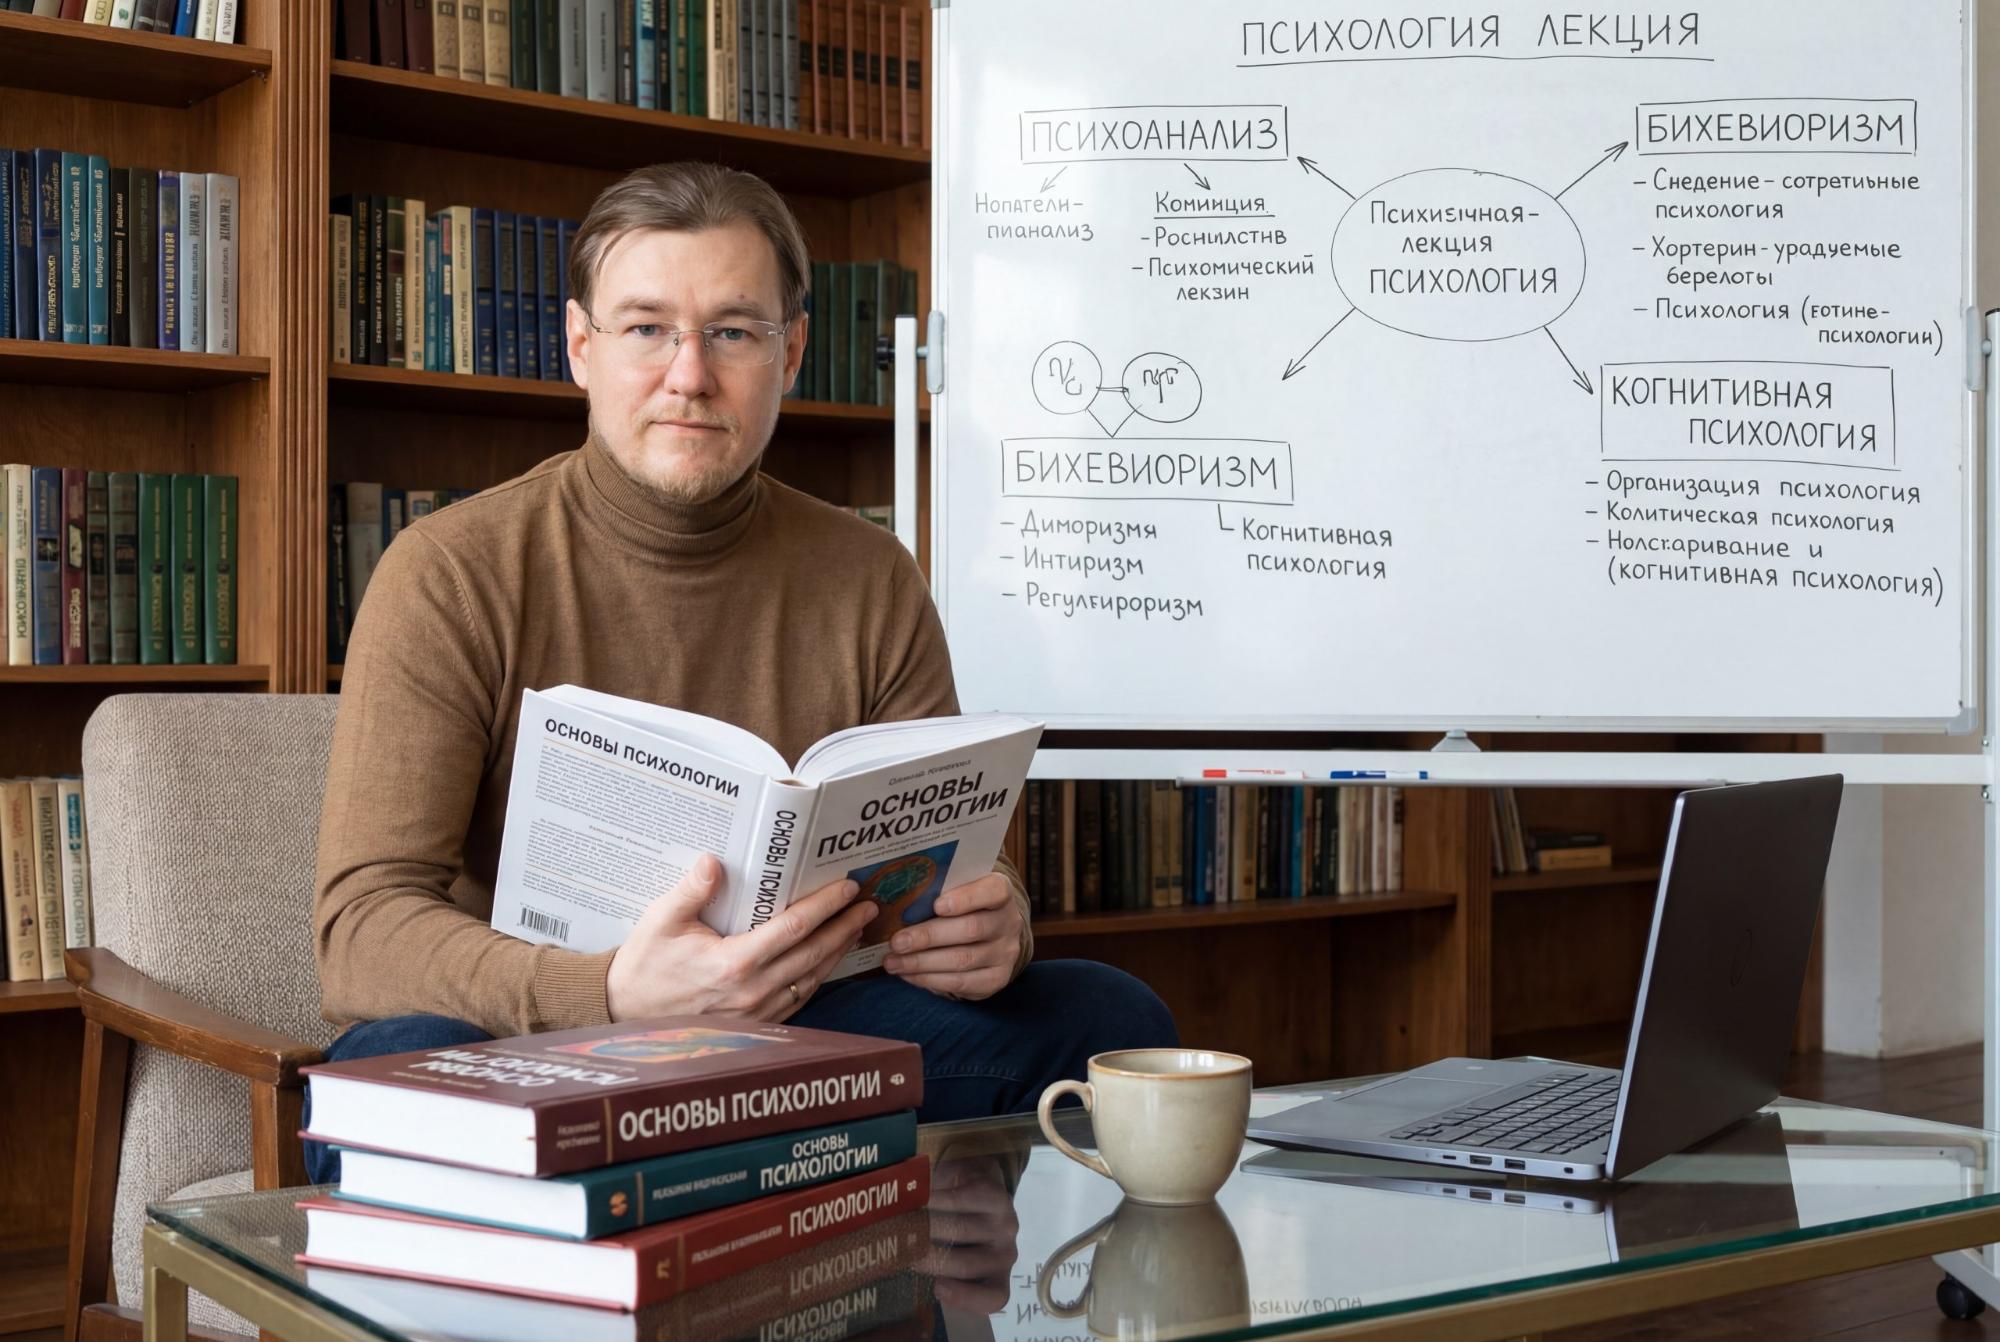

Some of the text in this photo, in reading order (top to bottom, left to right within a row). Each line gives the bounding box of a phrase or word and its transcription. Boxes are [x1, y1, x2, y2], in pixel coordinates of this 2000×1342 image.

[1243, 12, 1699, 56] ПСИХОЛОГИЯ ЛЕКЦИЯ
[1033, 119, 1278, 152] ПСИХОАНАЛИЗ
[1648, 113, 1903, 146] БИХЕВИОРИЗМ
[1656, 204, 1783, 219] психология
[1402, 236, 1492, 257] лекция
[1370, 267, 1557, 294] ПСИХОЛОГИЯ
[1656, 297, 1789, 319] Психология
[1613, 376, 1831, 409] КОГНИТИВНАЯ
[1690, 418, 1876, 452] ПСИХОЛОГИЯ
[1017, 450, 1277, 490] БИХЕВИОРИЗМ
[1607, 470, 1920, 504] Организация психология
[1243, 517, 1392, 547] Когнитивная
[1607, 500, 1894, 534] Колитическая психология
[1024, 545, 1143, 581] Интиризм
[1248, 554, 1386, 579] психология
[1809, 544, 1822, 558] и
[542, 718, 619, 758] ОСНОВЫ
[621, 745, 739, 800] ПСИХОЛОГИИ
[861, 772, 983, 821] ОСНОВЫ
[764, 810, 797, 867] ОСНОВЫ
[817, 788, 1008, 857] ПСИХОЛОГИИ
[619, 1095, 726, 1142] ОСНОВЫ
[731, 1070, 882, 1123] ПСИХОЛОГИИ
[792, 1132, 849, 1158] ОСНОВЫ
[760, 1143, 878, 1191] ПСИХОЛОГИИ
[789, 1179, 899, 1238] ПСИХОЛОГИИ
